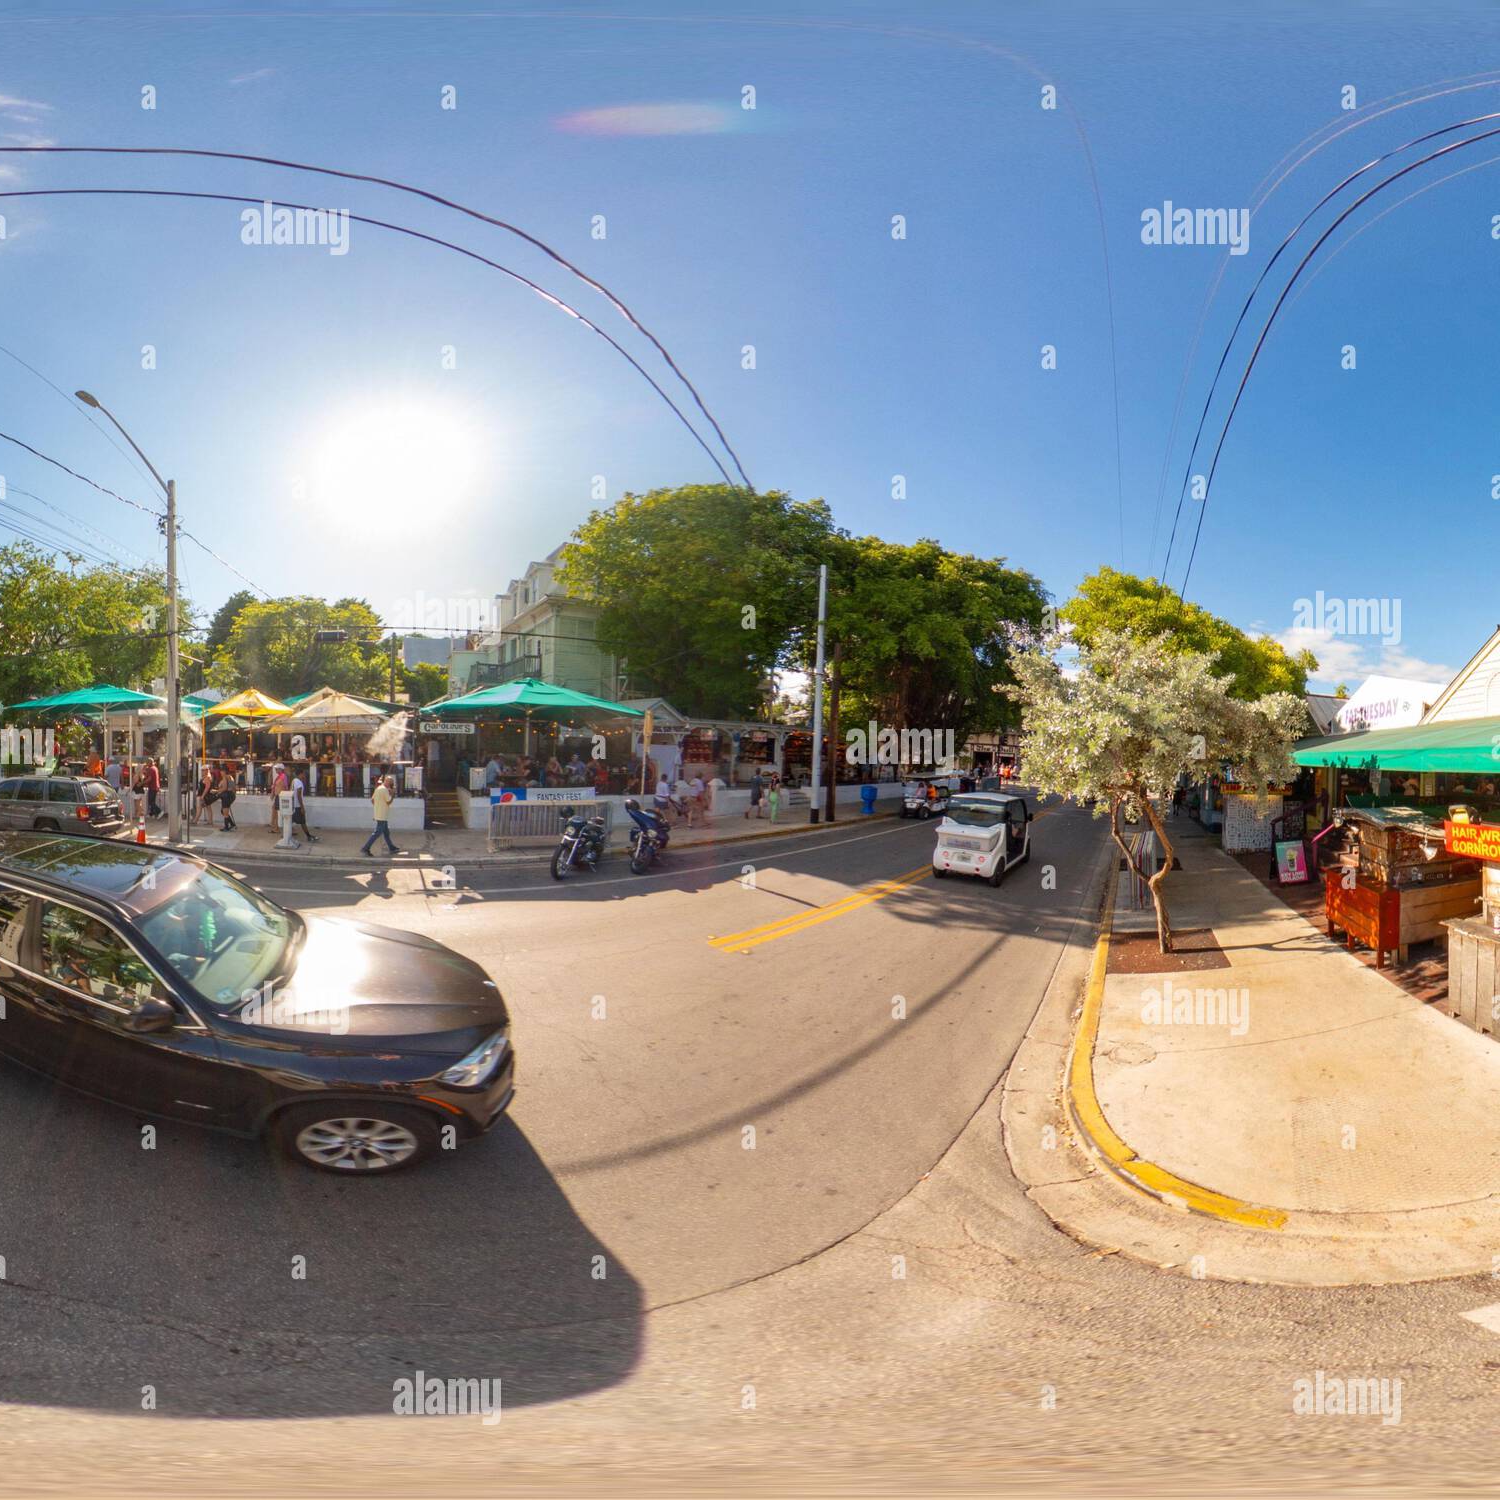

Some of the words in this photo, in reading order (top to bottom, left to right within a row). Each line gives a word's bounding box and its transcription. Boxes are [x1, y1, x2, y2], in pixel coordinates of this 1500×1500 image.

[1359, 697, 1399, 722] TUESDAY
[536, 793, 565, 801] FANTASY
[565, 792, 581, 801] FEST
[1451, 826, 1477, 839] HAIR
[1452, 840, 1500, 858] CORNRO
